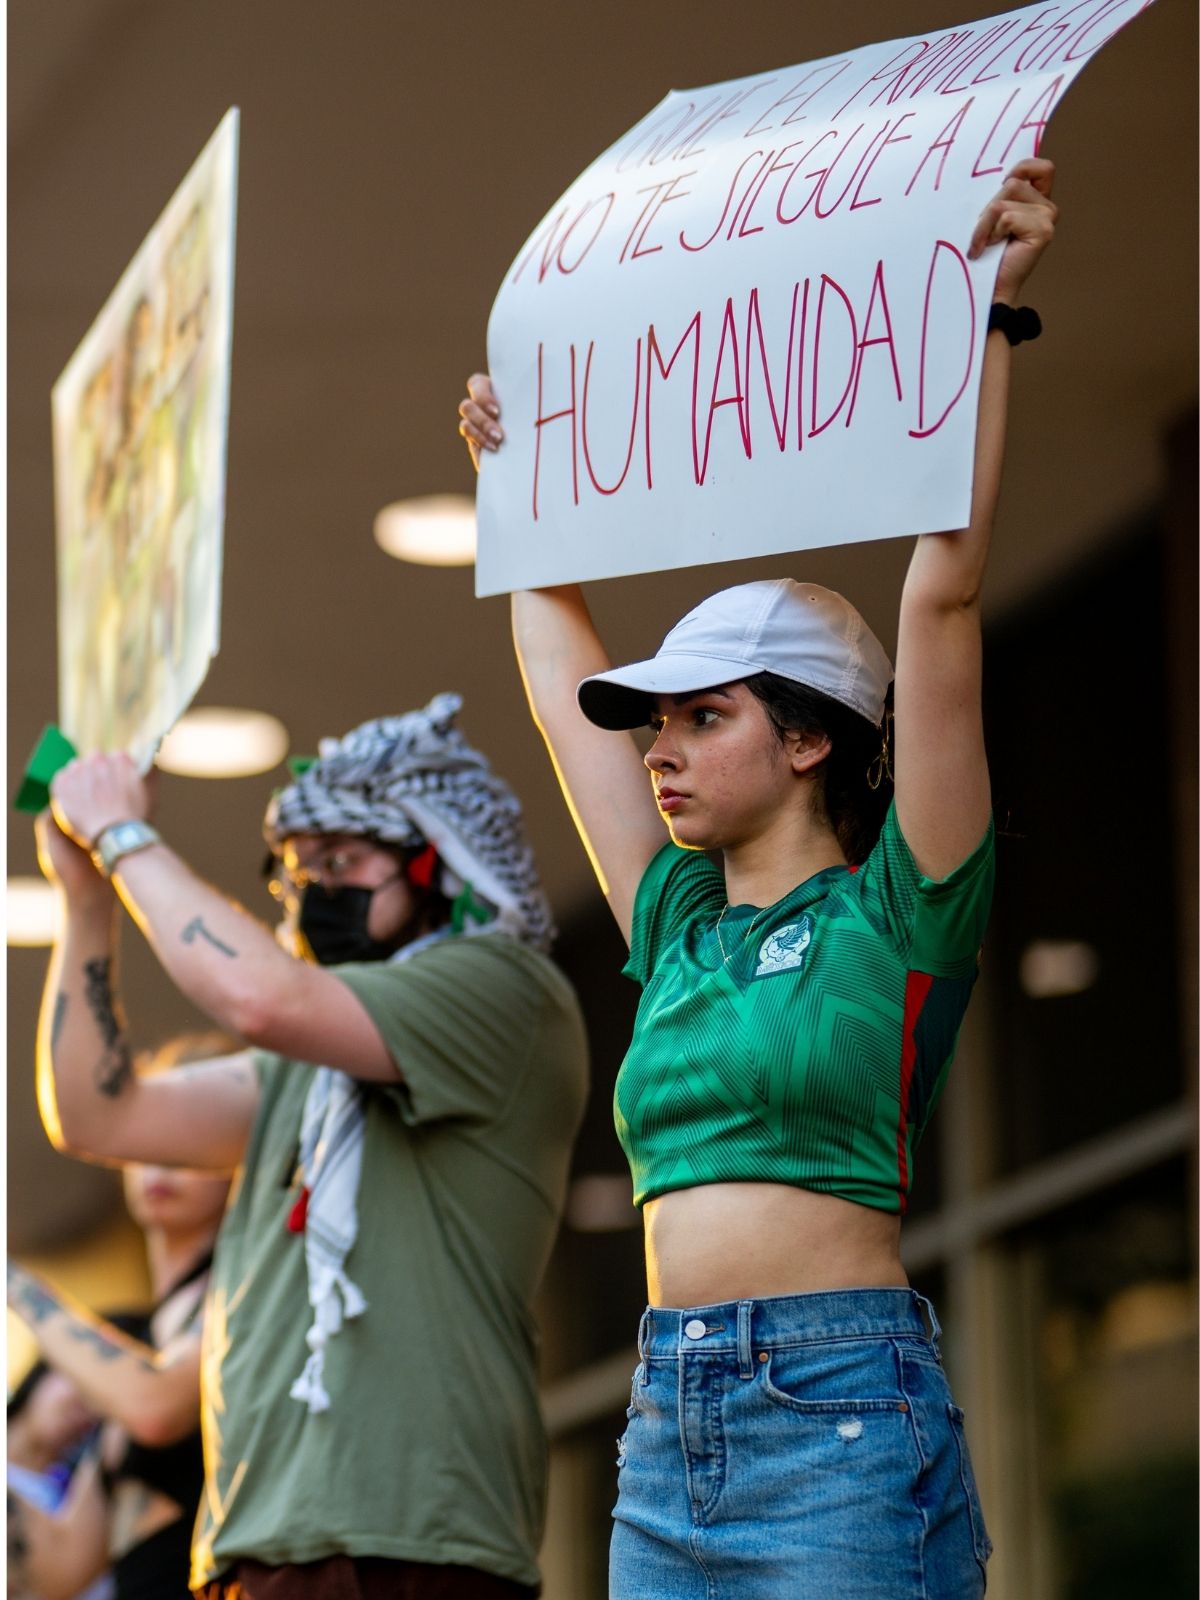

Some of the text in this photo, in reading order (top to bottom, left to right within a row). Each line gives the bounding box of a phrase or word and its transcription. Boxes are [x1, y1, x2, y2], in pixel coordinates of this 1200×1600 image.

[512, 73, 1066, 285] NO TE SIEGUE A LA
[743, 58, 854, 138] EL
[533, 239, 976, 521] HUMANIDAD
